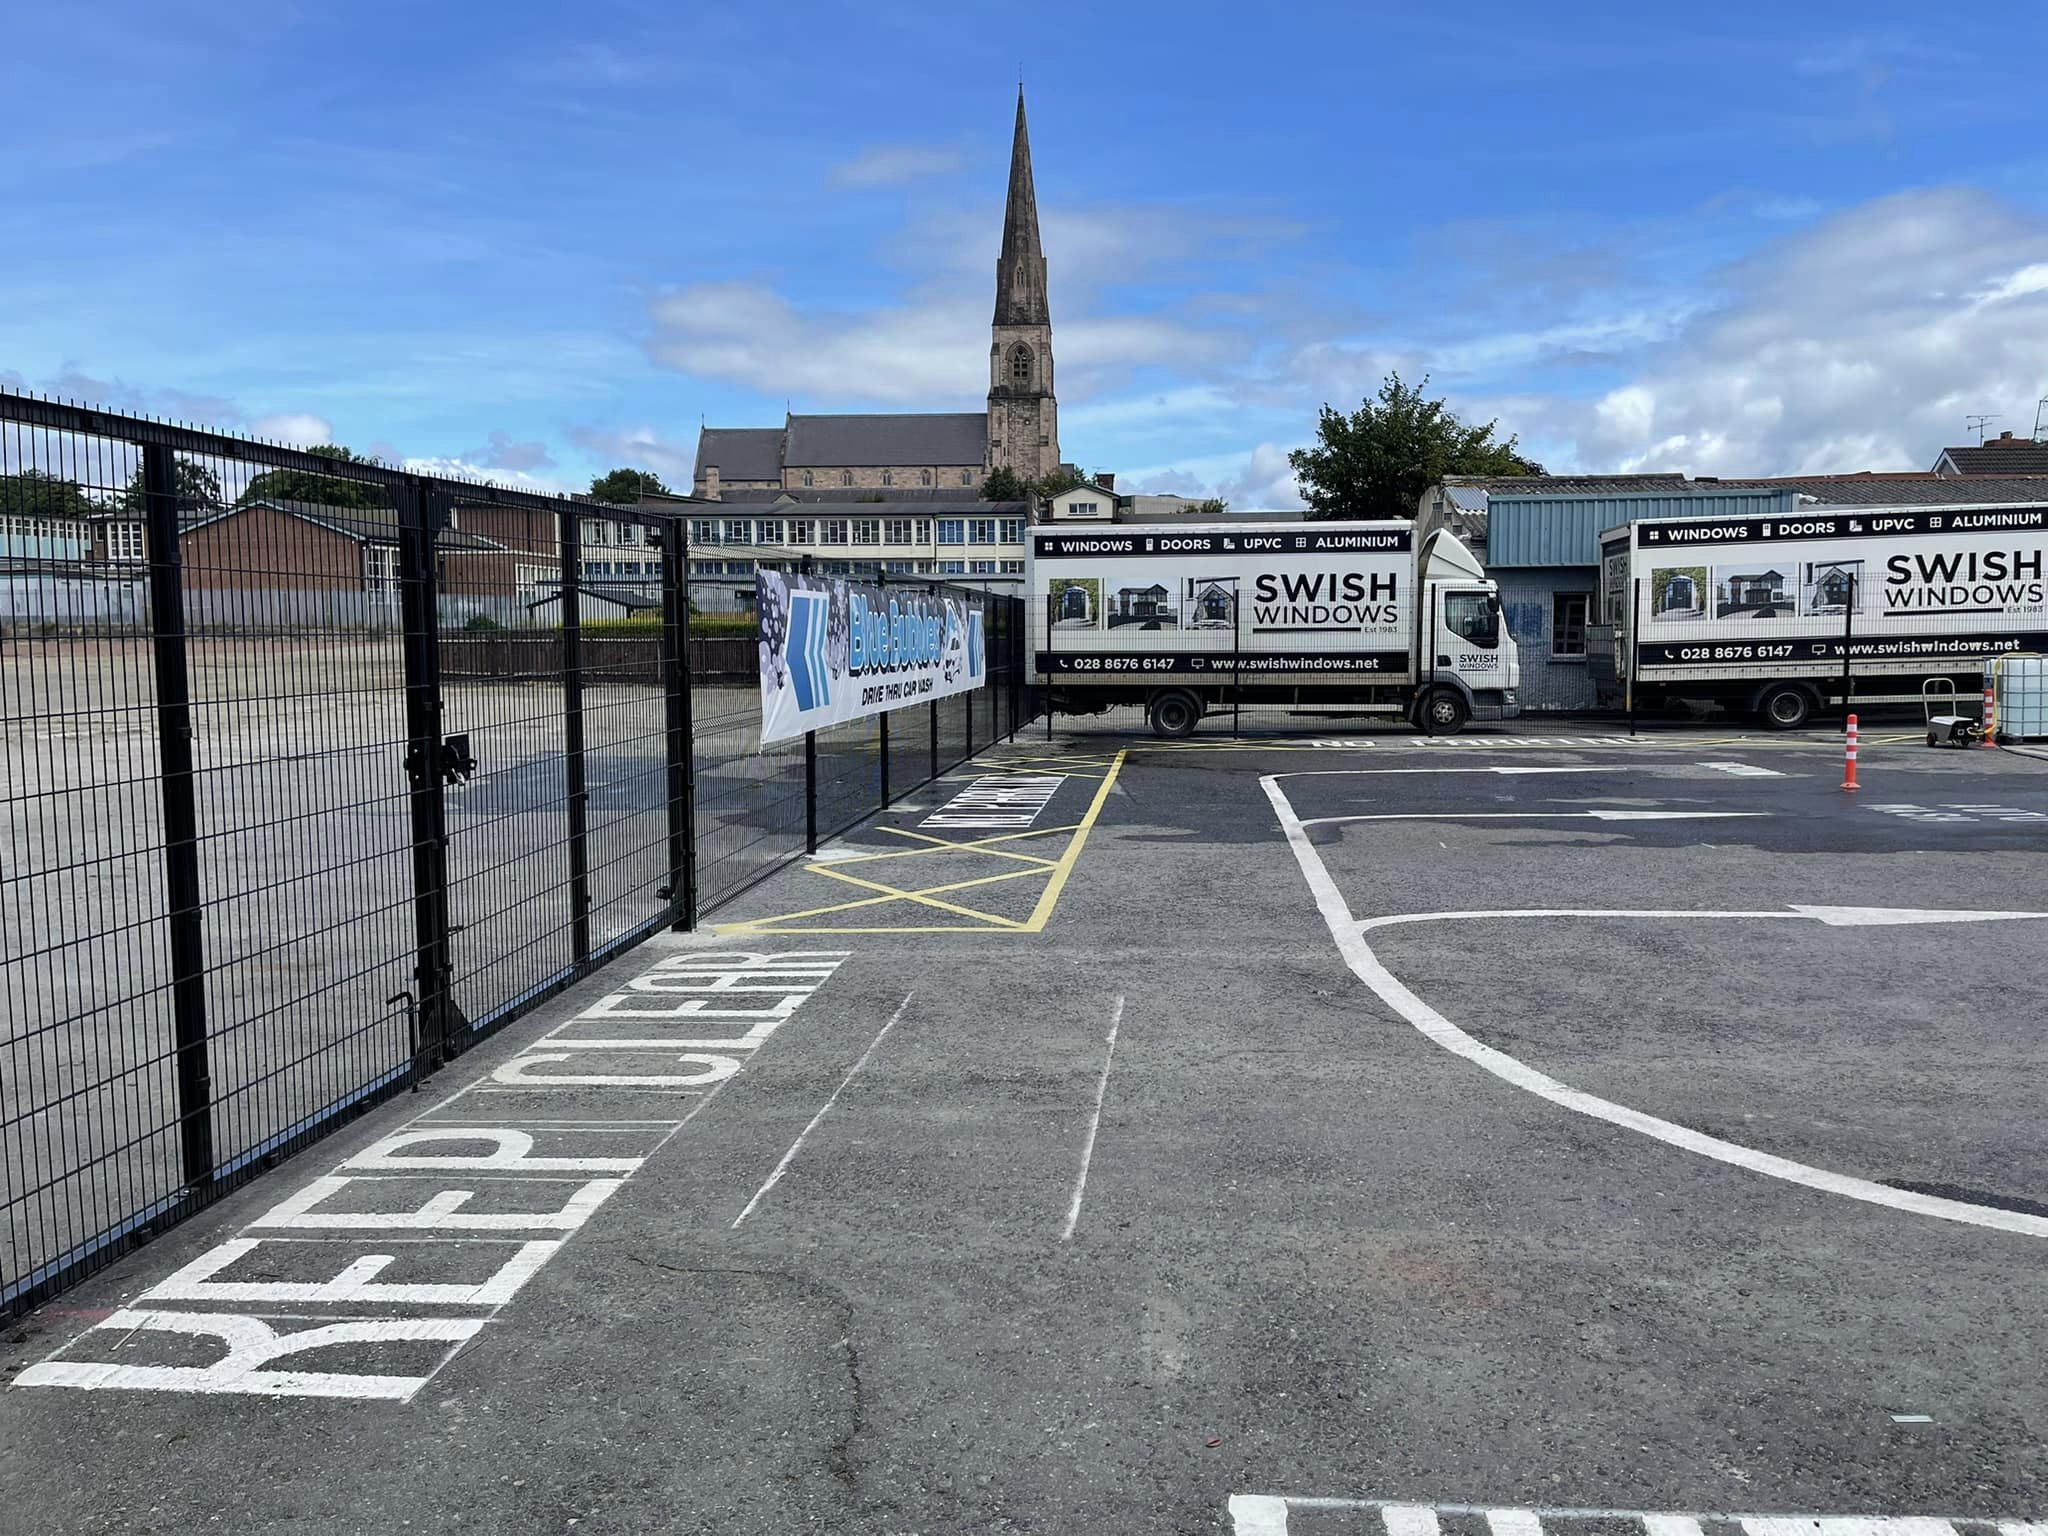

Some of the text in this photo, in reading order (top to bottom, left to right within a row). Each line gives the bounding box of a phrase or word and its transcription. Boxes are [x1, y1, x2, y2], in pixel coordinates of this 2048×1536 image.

[1668, 513, 2043, 541] WINDOWS DOORS UPVC ALUMINIUM
[1061, 536, 1399, 552] WINDOWS DOORS UPVC ALUMINIUM
[1886, 550, 2042, 585] SWISH
[1254, 573, 1397, 603] SWISH
[1884, 583, 2044, 608] WINDOWS
[1254, 605, 1398, 624] WINDOWS
[2007, 605, 2044, 614] Est 1983
[849, 593, 942, 671] Blue Bubbles
[1681, 645, 1794, 660] 028 8676 6147
[1834, 639, 2021, 655] www.swishwindows.net
[1074, 658, 1175, 670] 028 8676 6147
[1211, 657, 1379, 669] www.swishwindows.net
[1460, 654, 1499, 663] SWISH
[861, 677, 934, 706] DRIVE THRU CAR WASH
[917, 814, 1034, 828] NO
[12, 949, 853, 1400] KEEP CLEAR
